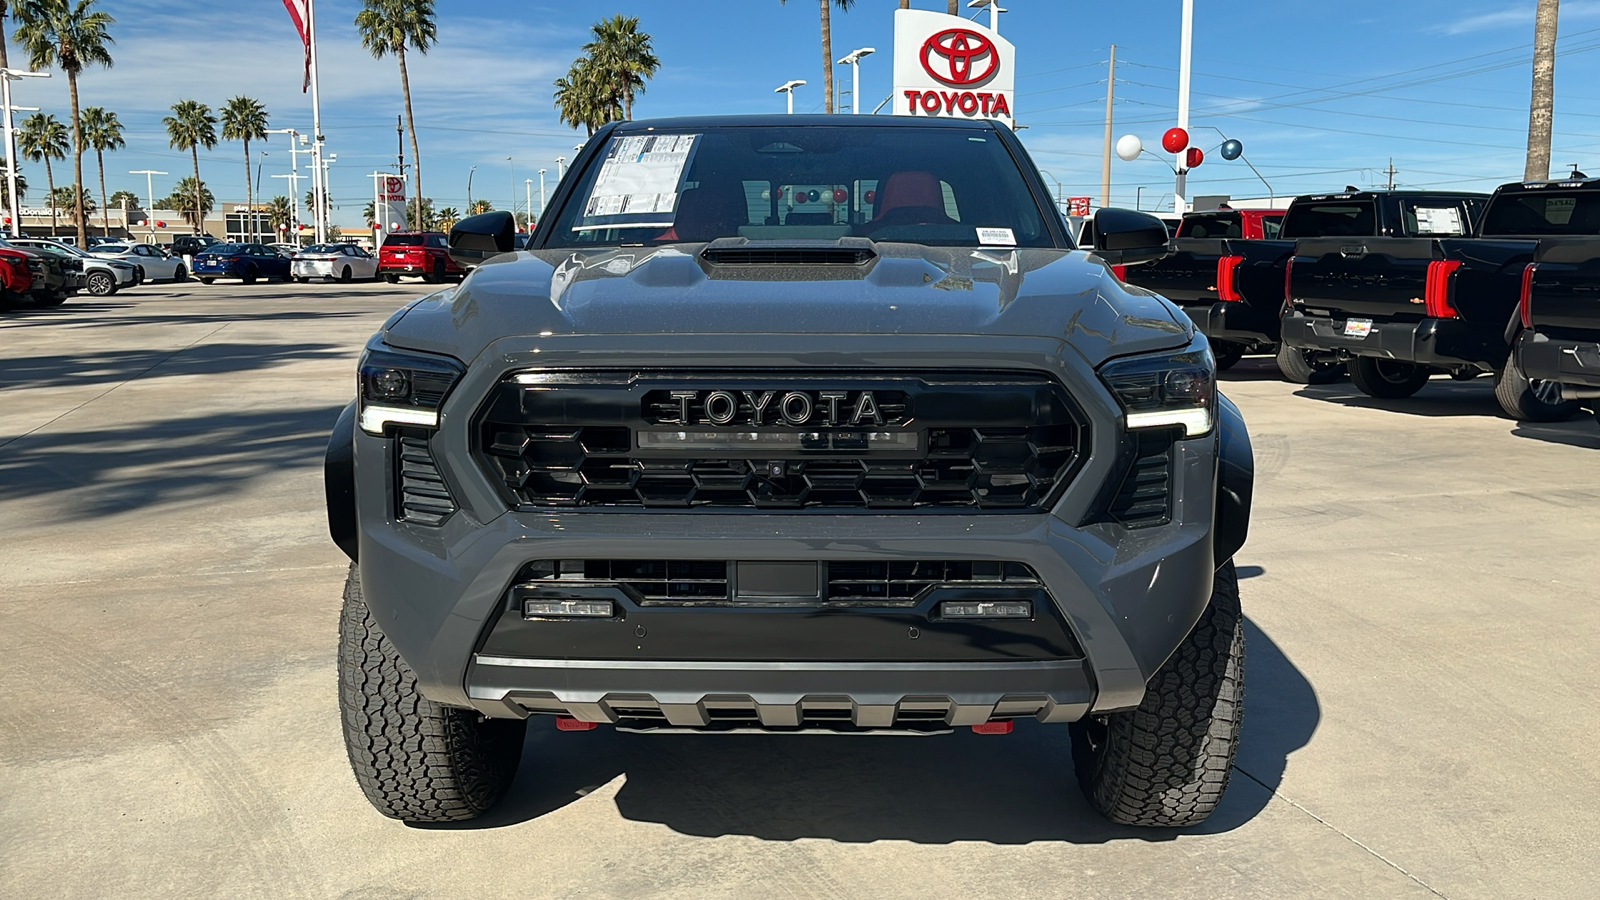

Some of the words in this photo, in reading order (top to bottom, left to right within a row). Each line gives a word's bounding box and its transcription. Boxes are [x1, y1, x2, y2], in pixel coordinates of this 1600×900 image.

[904, 90, 1010, 116] TOYOTA
[19, 208, 61, 216] cDonalds
[670, 390, 886, 426] TOYOTA
